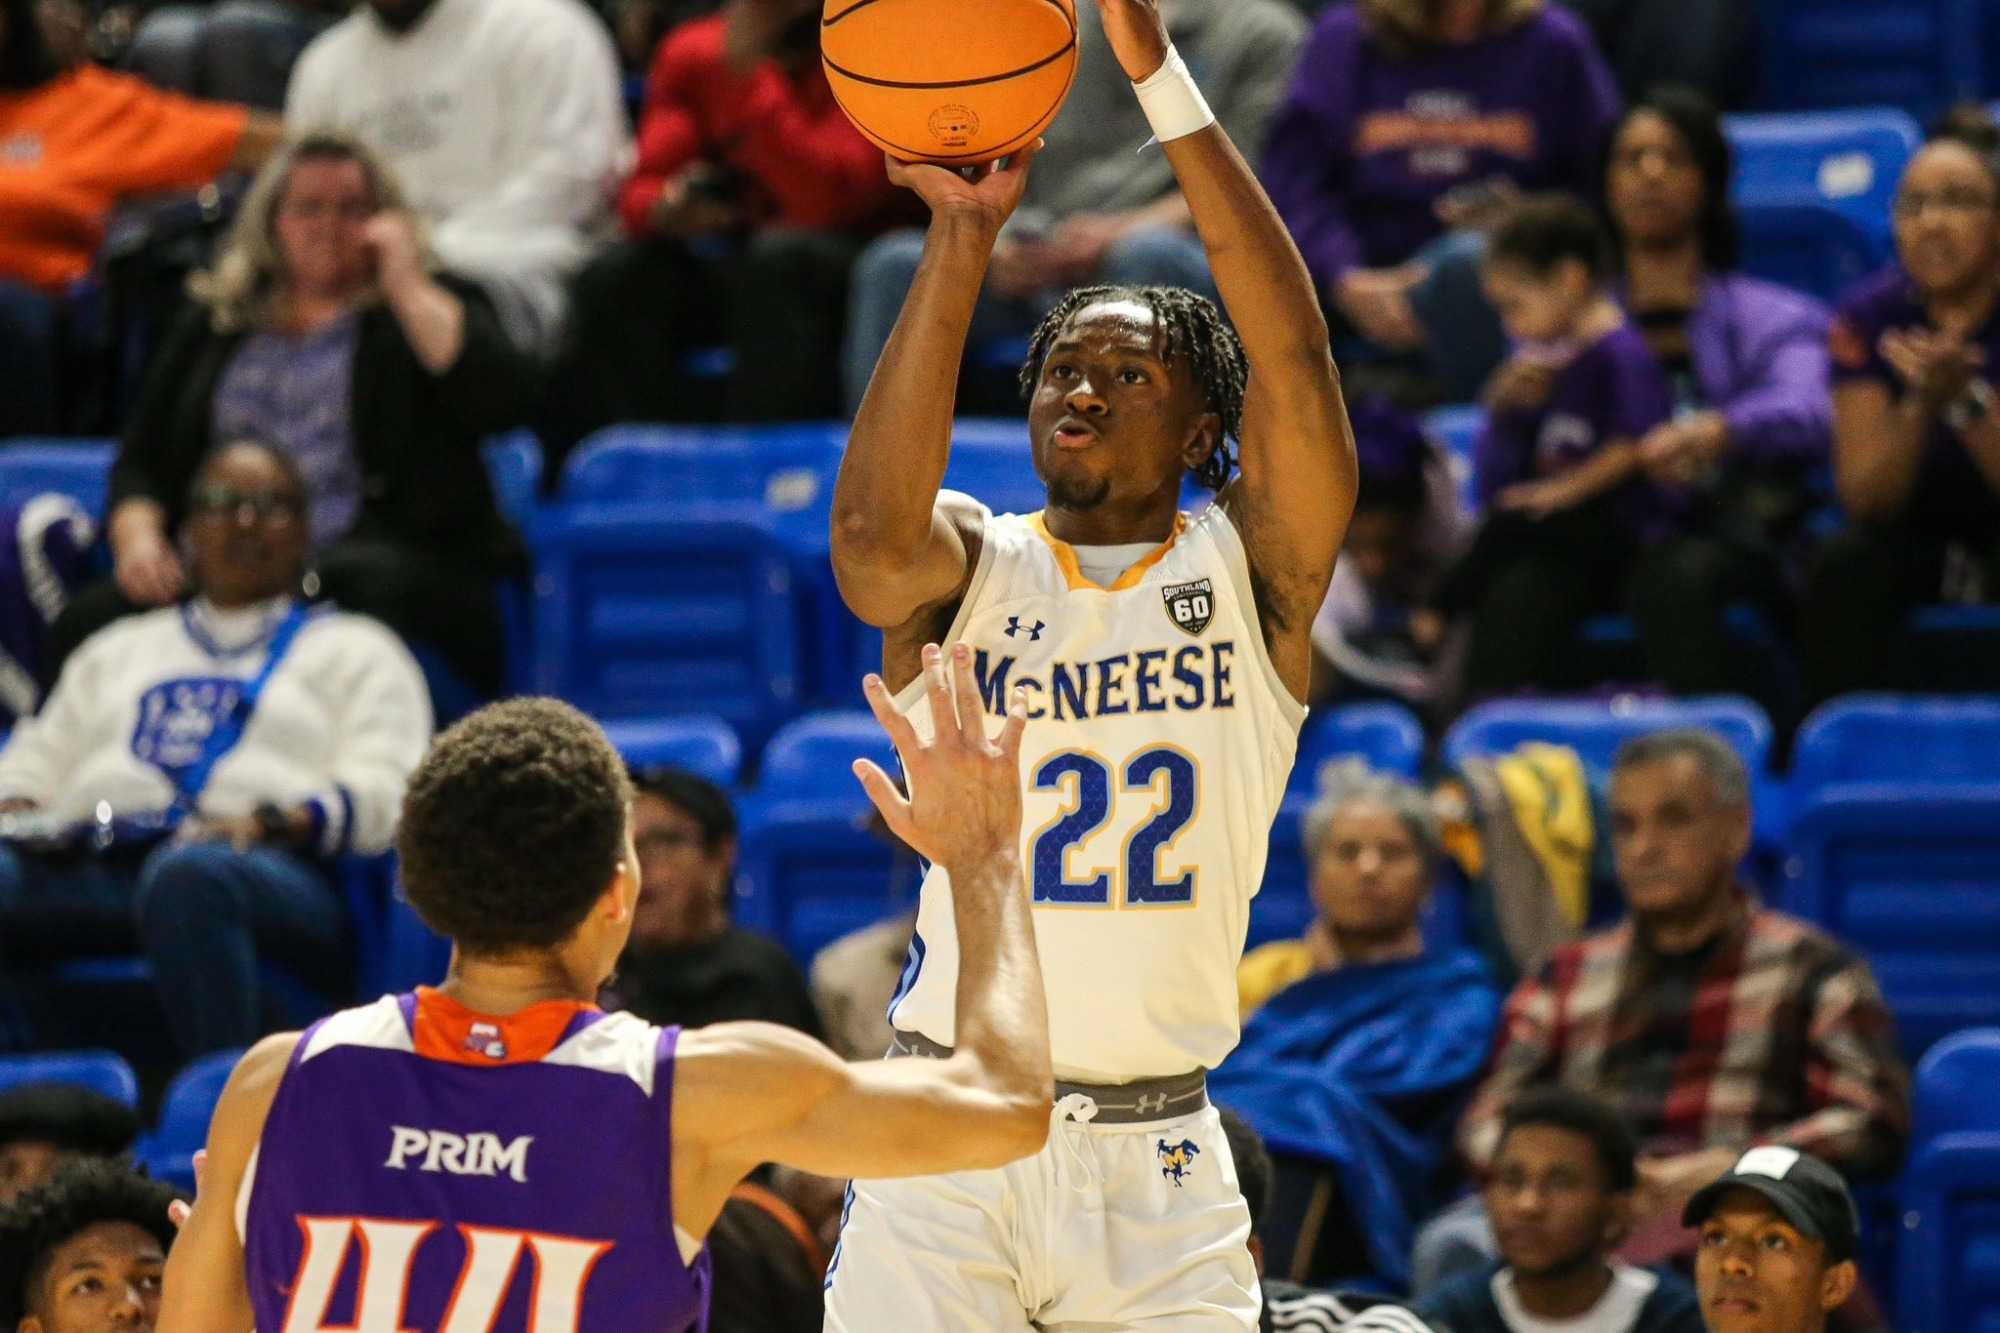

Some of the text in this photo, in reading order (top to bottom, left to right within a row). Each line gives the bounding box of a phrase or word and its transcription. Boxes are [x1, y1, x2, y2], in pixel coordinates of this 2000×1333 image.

[1163, 579, 1211, 601] SOUTHLAND
[1174, 595, 1210, 622] 60
[1026, 741, 1201, 911] 22
[383, 1124, 535, 1183] PRIM
